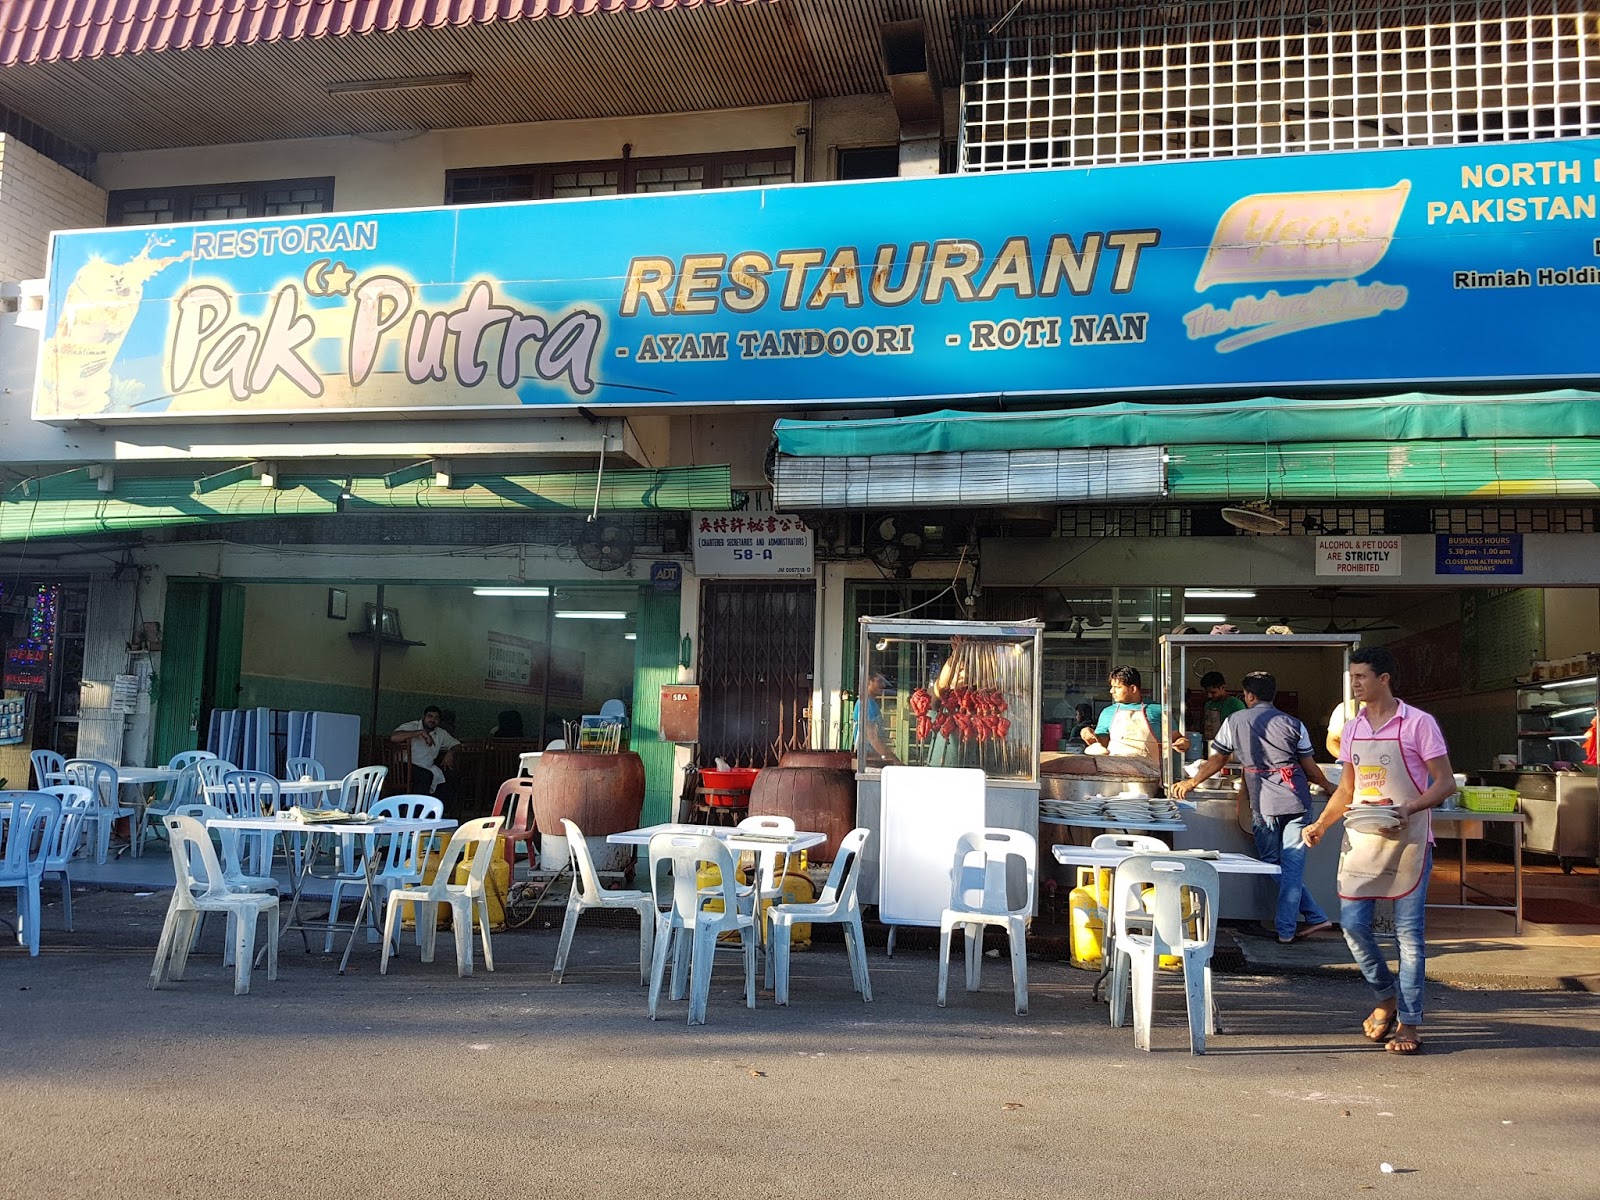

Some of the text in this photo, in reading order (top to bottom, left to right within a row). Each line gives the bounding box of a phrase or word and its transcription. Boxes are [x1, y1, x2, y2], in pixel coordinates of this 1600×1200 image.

[1461, 160, 1581, 189] NORTH
[1427, 194, 1596, 225] PAKISTAN
[193, 221, 377, 260] RESTORAN
[1245, 207, 1374, 264] Yeo's
[619, 228, 1161, 317] RESTAURANT
[1454, 270, 1530, 288] Rimiah
[1187, 310, 1226, 336] The
[172, 274, 601, 401] Pak Putra
[636, 332, 728, 362] AYAM
[739, 325, 914, 360] TANDOORI
[970, 317, 1060, 350] ROTI
[1070, 313, 1149, 345] NAN
[727, 538, 753, 547] SECRETARIES
[756, 538, 765, 547] AND
[1319, 540, 1398, 549] ALCOHOL & PET DOGS
[1448, 537, 1510, 545] BUSINESS HOURS
[733, 549, 773, 560] 58-A
[1327, 551, 1389, 561] ARE STRICTLY
[655, 567, 677, 580] ADT
[1337, 563, 1380, 572] PROHIBITED
[672, 693, 688, 701] 58A
[1359, 771, 1381, 781] Dairy
[281, 812, 291, 820] 32
